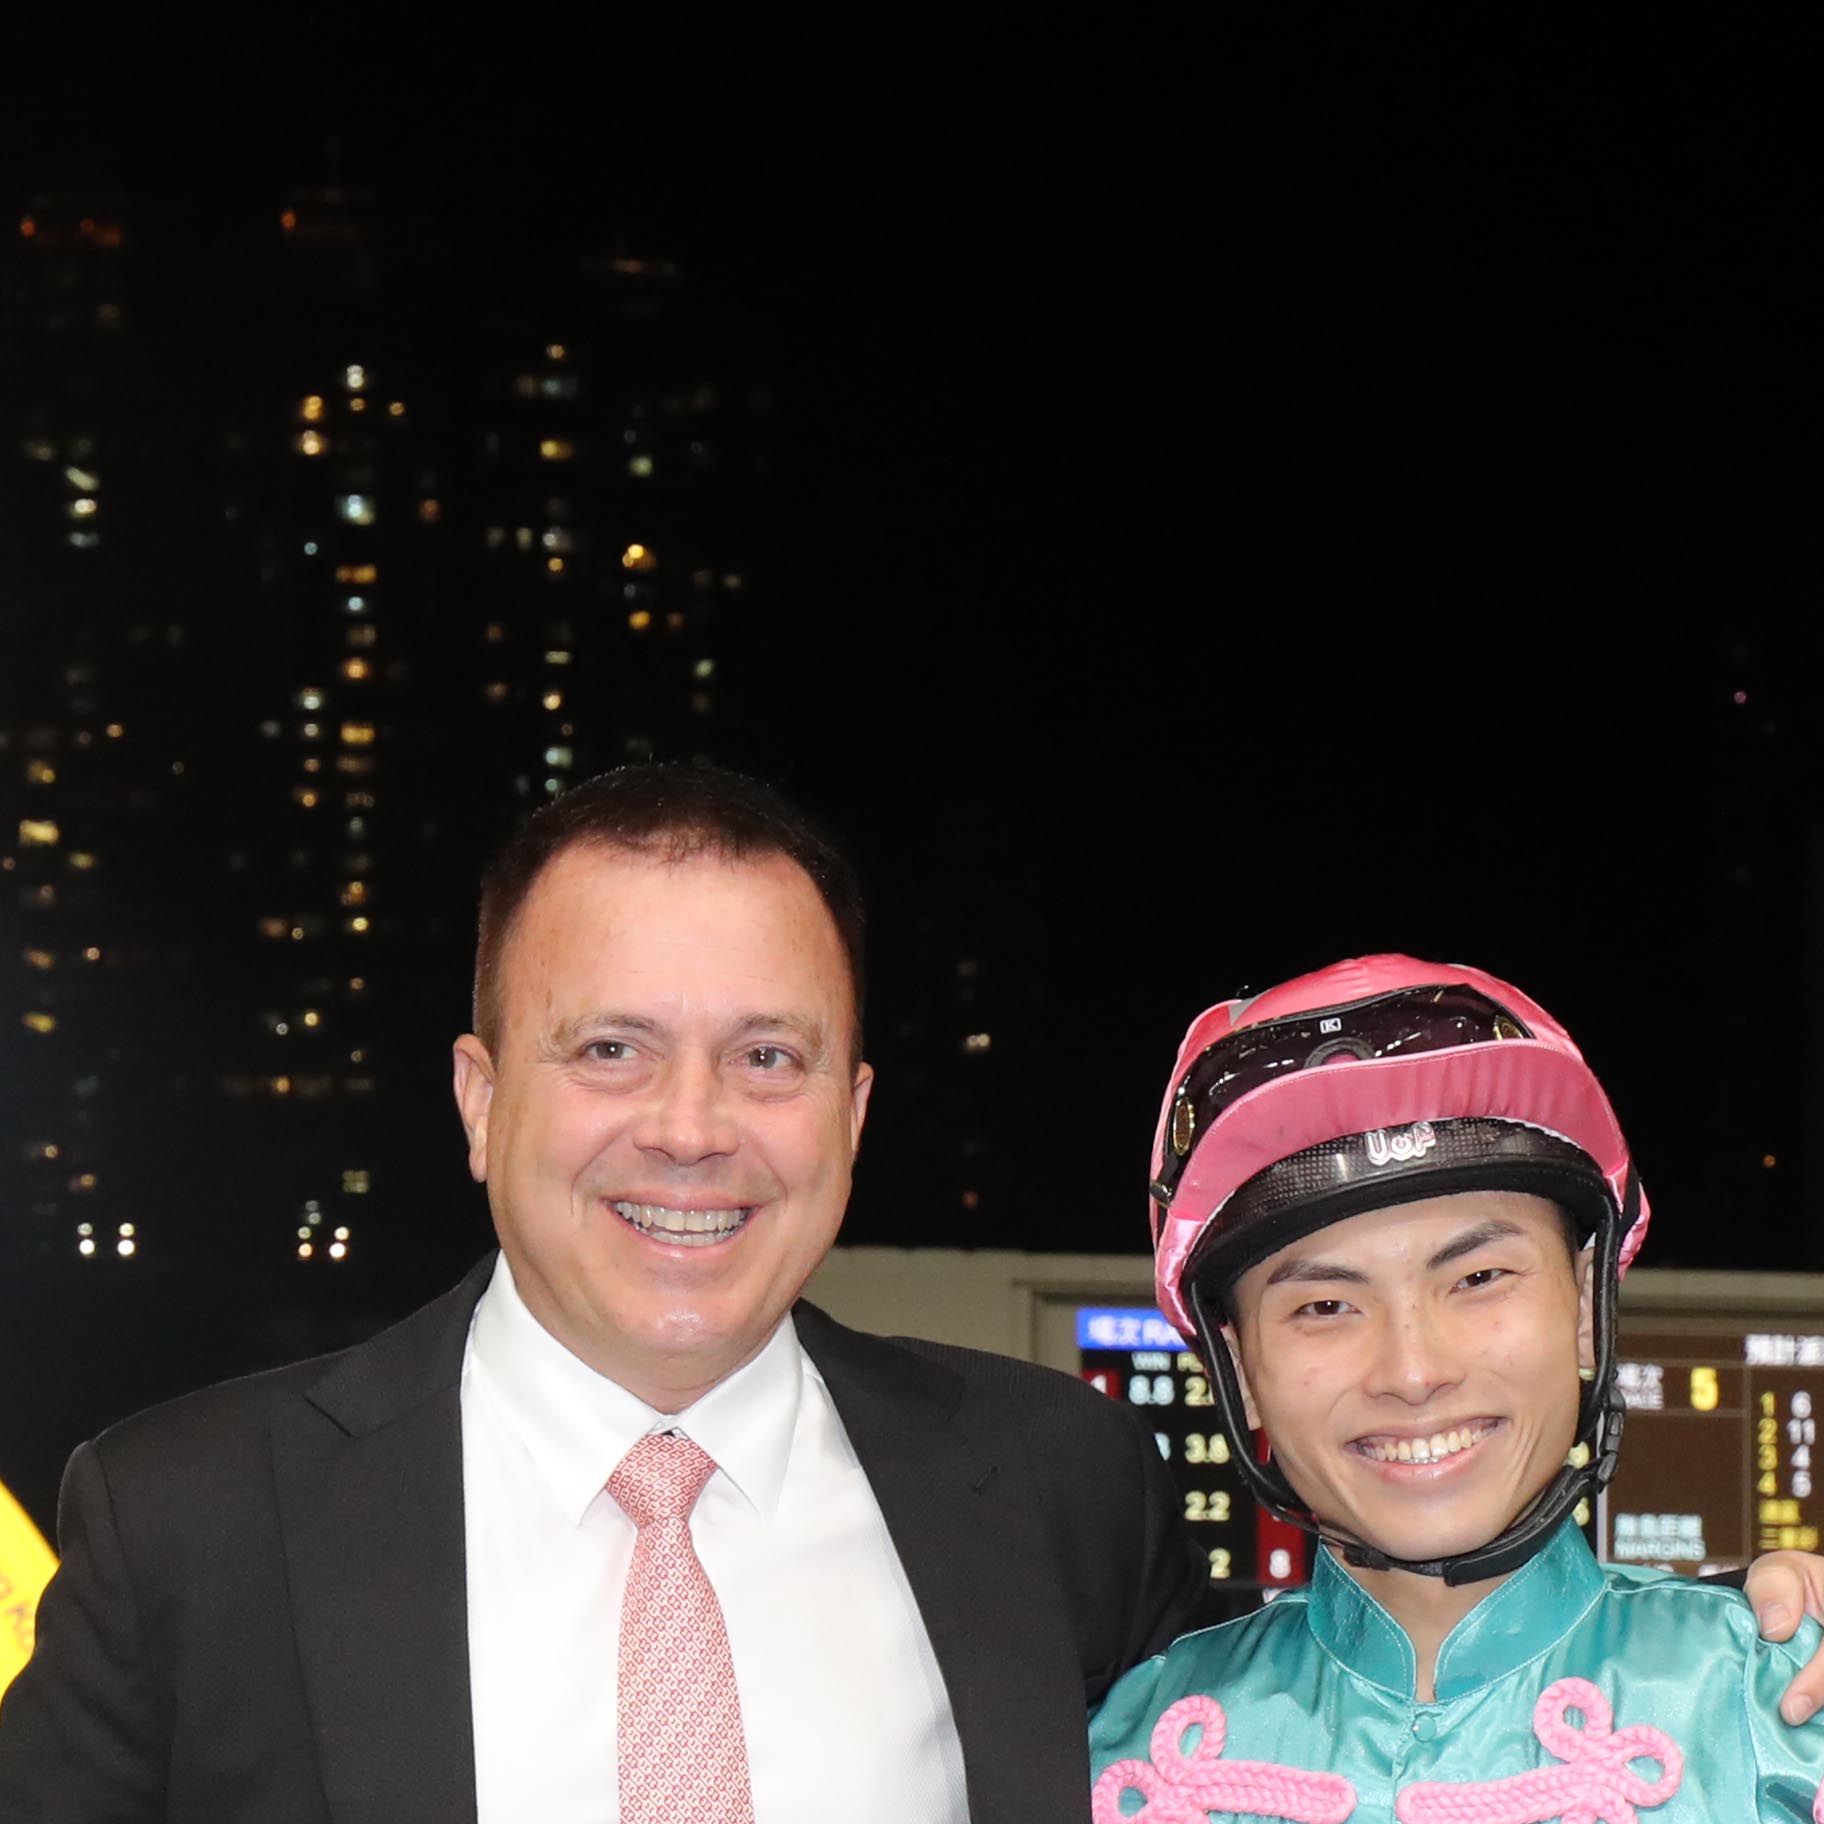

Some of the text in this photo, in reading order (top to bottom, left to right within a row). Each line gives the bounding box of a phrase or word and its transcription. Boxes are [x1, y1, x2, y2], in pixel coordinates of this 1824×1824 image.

[1128, 1374, 1175, 1405] 8.8
[1691, 1366, 1719, 1411] 5
[1758, 1417, 1777, 1444] 2
[1787, 1418, 1815, 1445] 11
[1758, 1444, 1777, 1470] 3
[1790, 1445, 1810, 1470] 4
[1757, 1471, 1777, 1496] 4
[1184, 1491, 1230, 1521] 2.2
[1614, 1537, 1706, 1561] MARGINS
